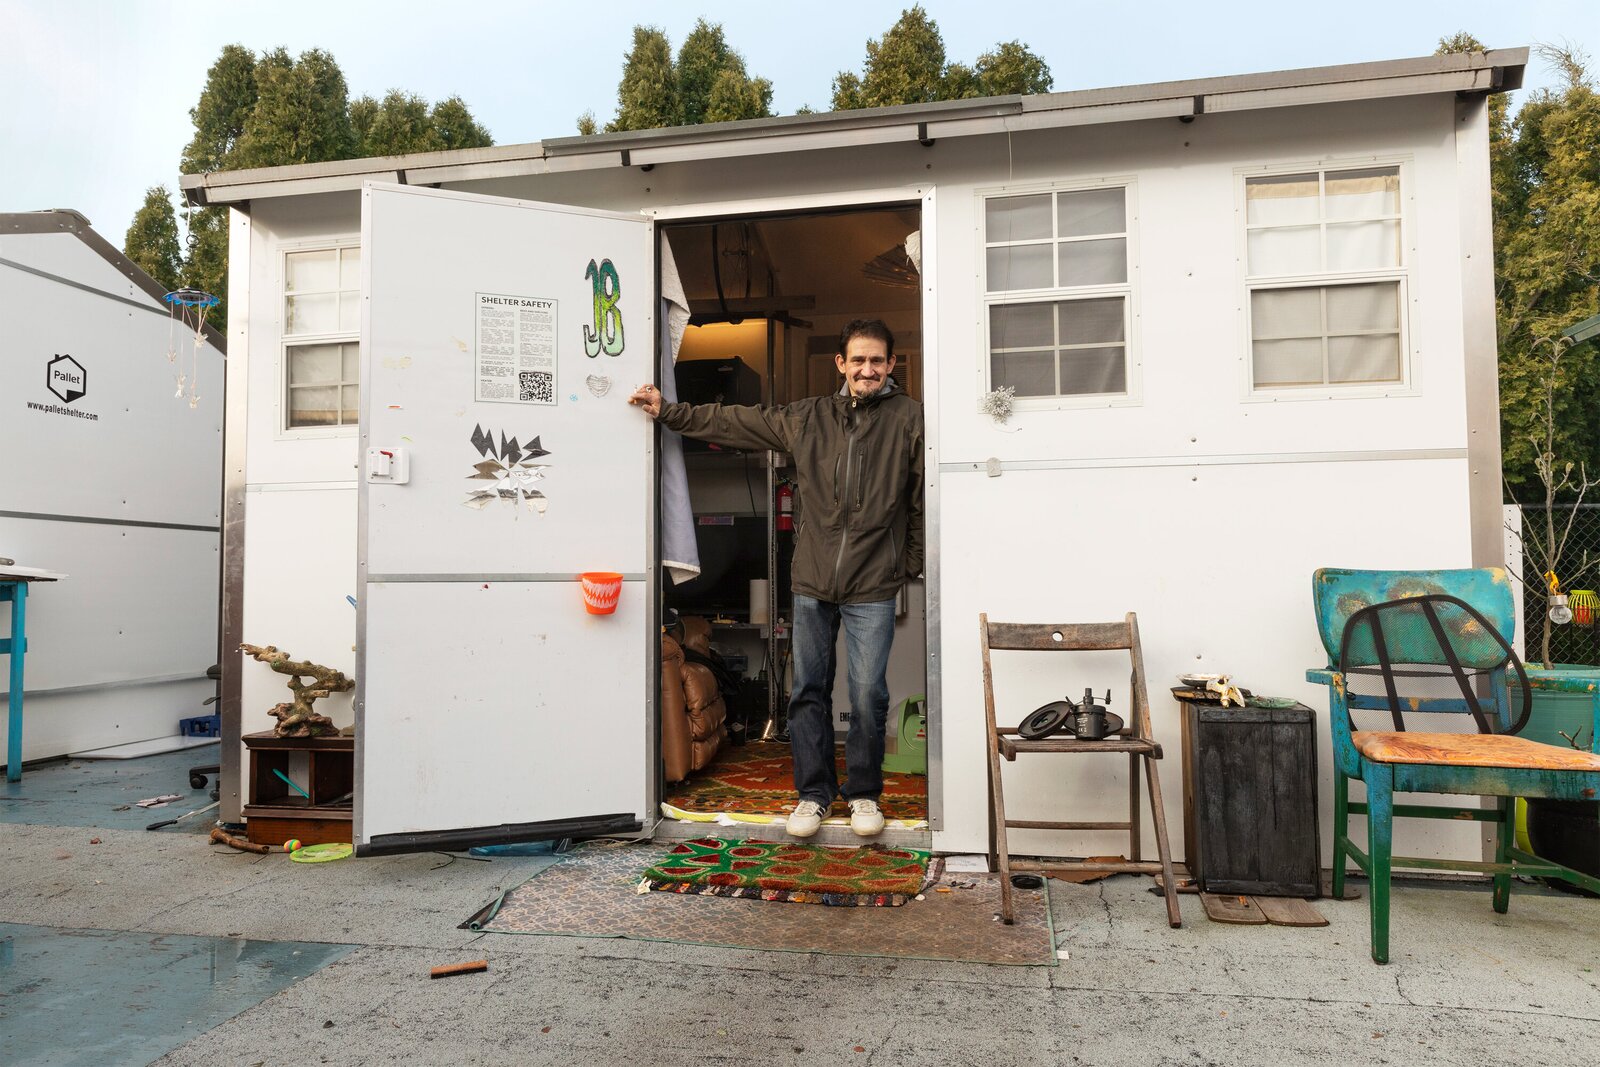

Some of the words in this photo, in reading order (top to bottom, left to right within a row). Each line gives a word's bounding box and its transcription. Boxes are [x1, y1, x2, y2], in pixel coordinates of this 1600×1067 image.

[481, 296, 519, 306] SHELTER
[521, 299, 553, 309] SAFETY
[54, 370, 81, 384] Pallet
[27, 401, 99, 421] www.palletshelter.com
